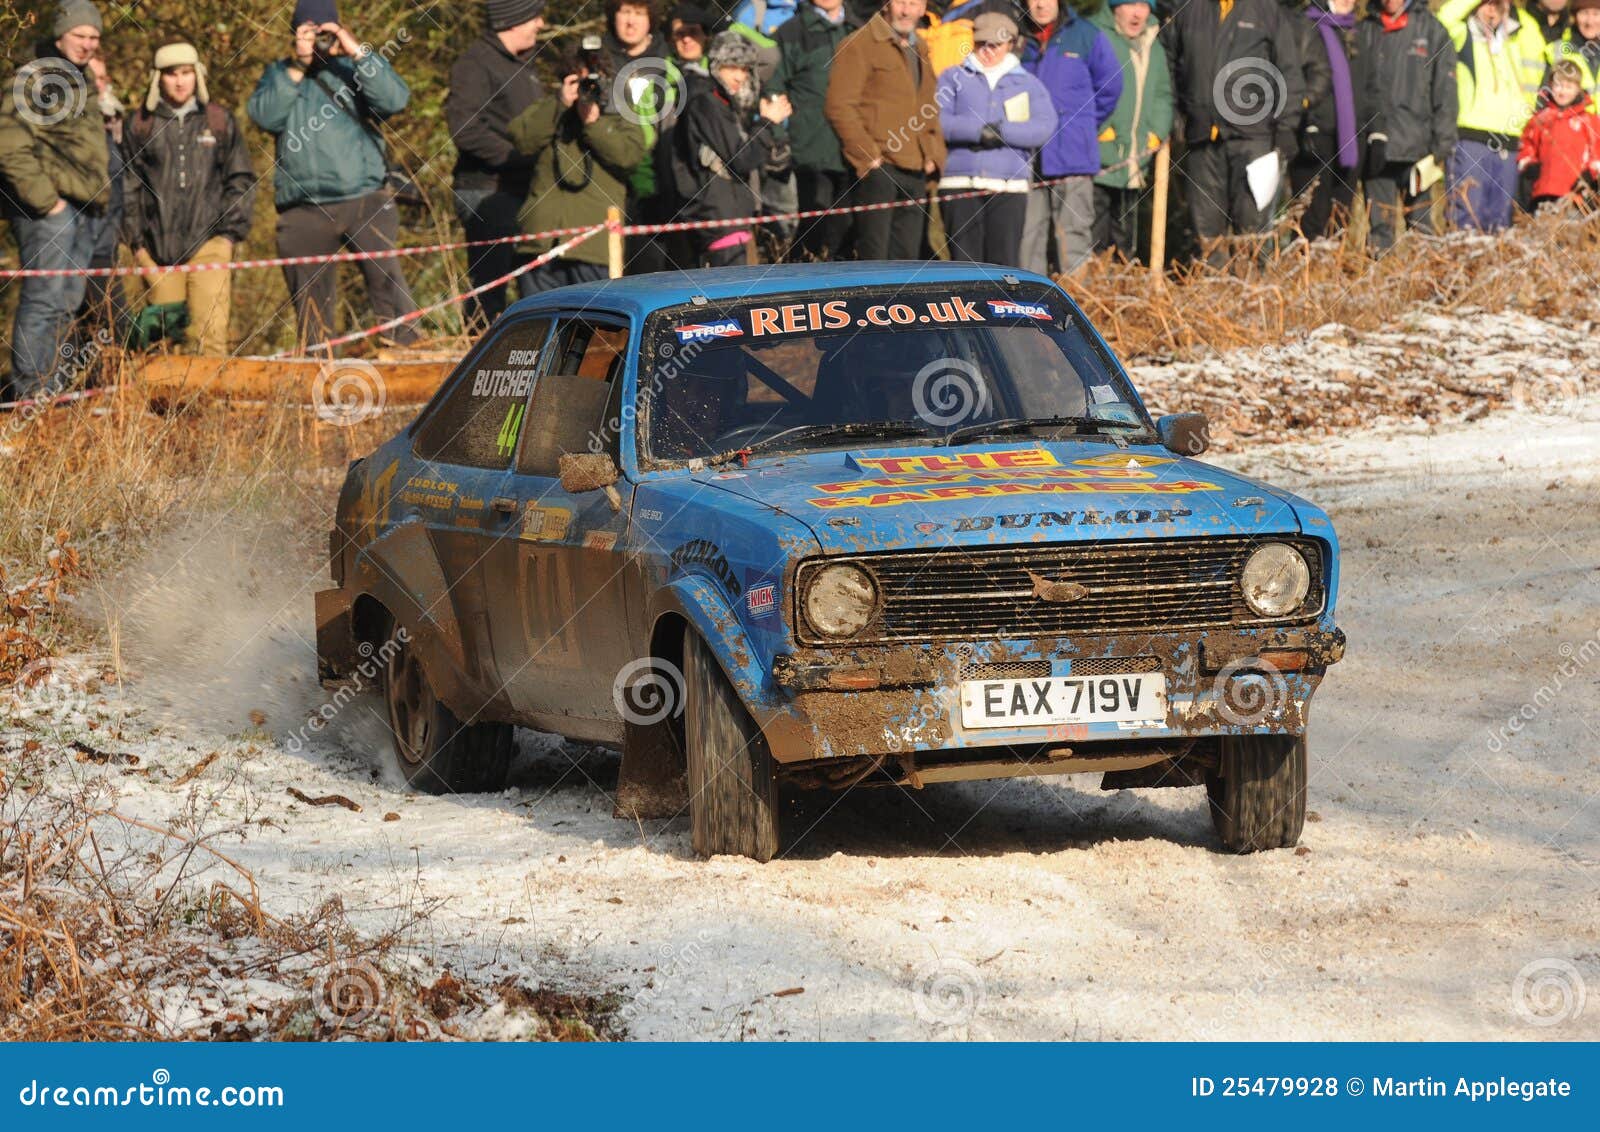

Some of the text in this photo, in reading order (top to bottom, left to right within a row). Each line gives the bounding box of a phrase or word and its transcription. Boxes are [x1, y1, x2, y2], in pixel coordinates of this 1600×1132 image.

[749, 296, 986, 337] REIS.co.uk
[993, 304, 1047, 317] BTRDA
[682, 322, 738, 340] BTRDA
[508, 349, 539, 365] BRICK
[471, 369, 536, 397] BUTCHER
[496, 402, 525, 457] 44
[856, 449, 1063, 474] THE
[812, 467, 1157, 494] FLYING
[807, 481, 1225, 509] FARMER
[953, 508, 1192, 533] DUNLOP
[984, 678, 1142, 718] EAX 719V
